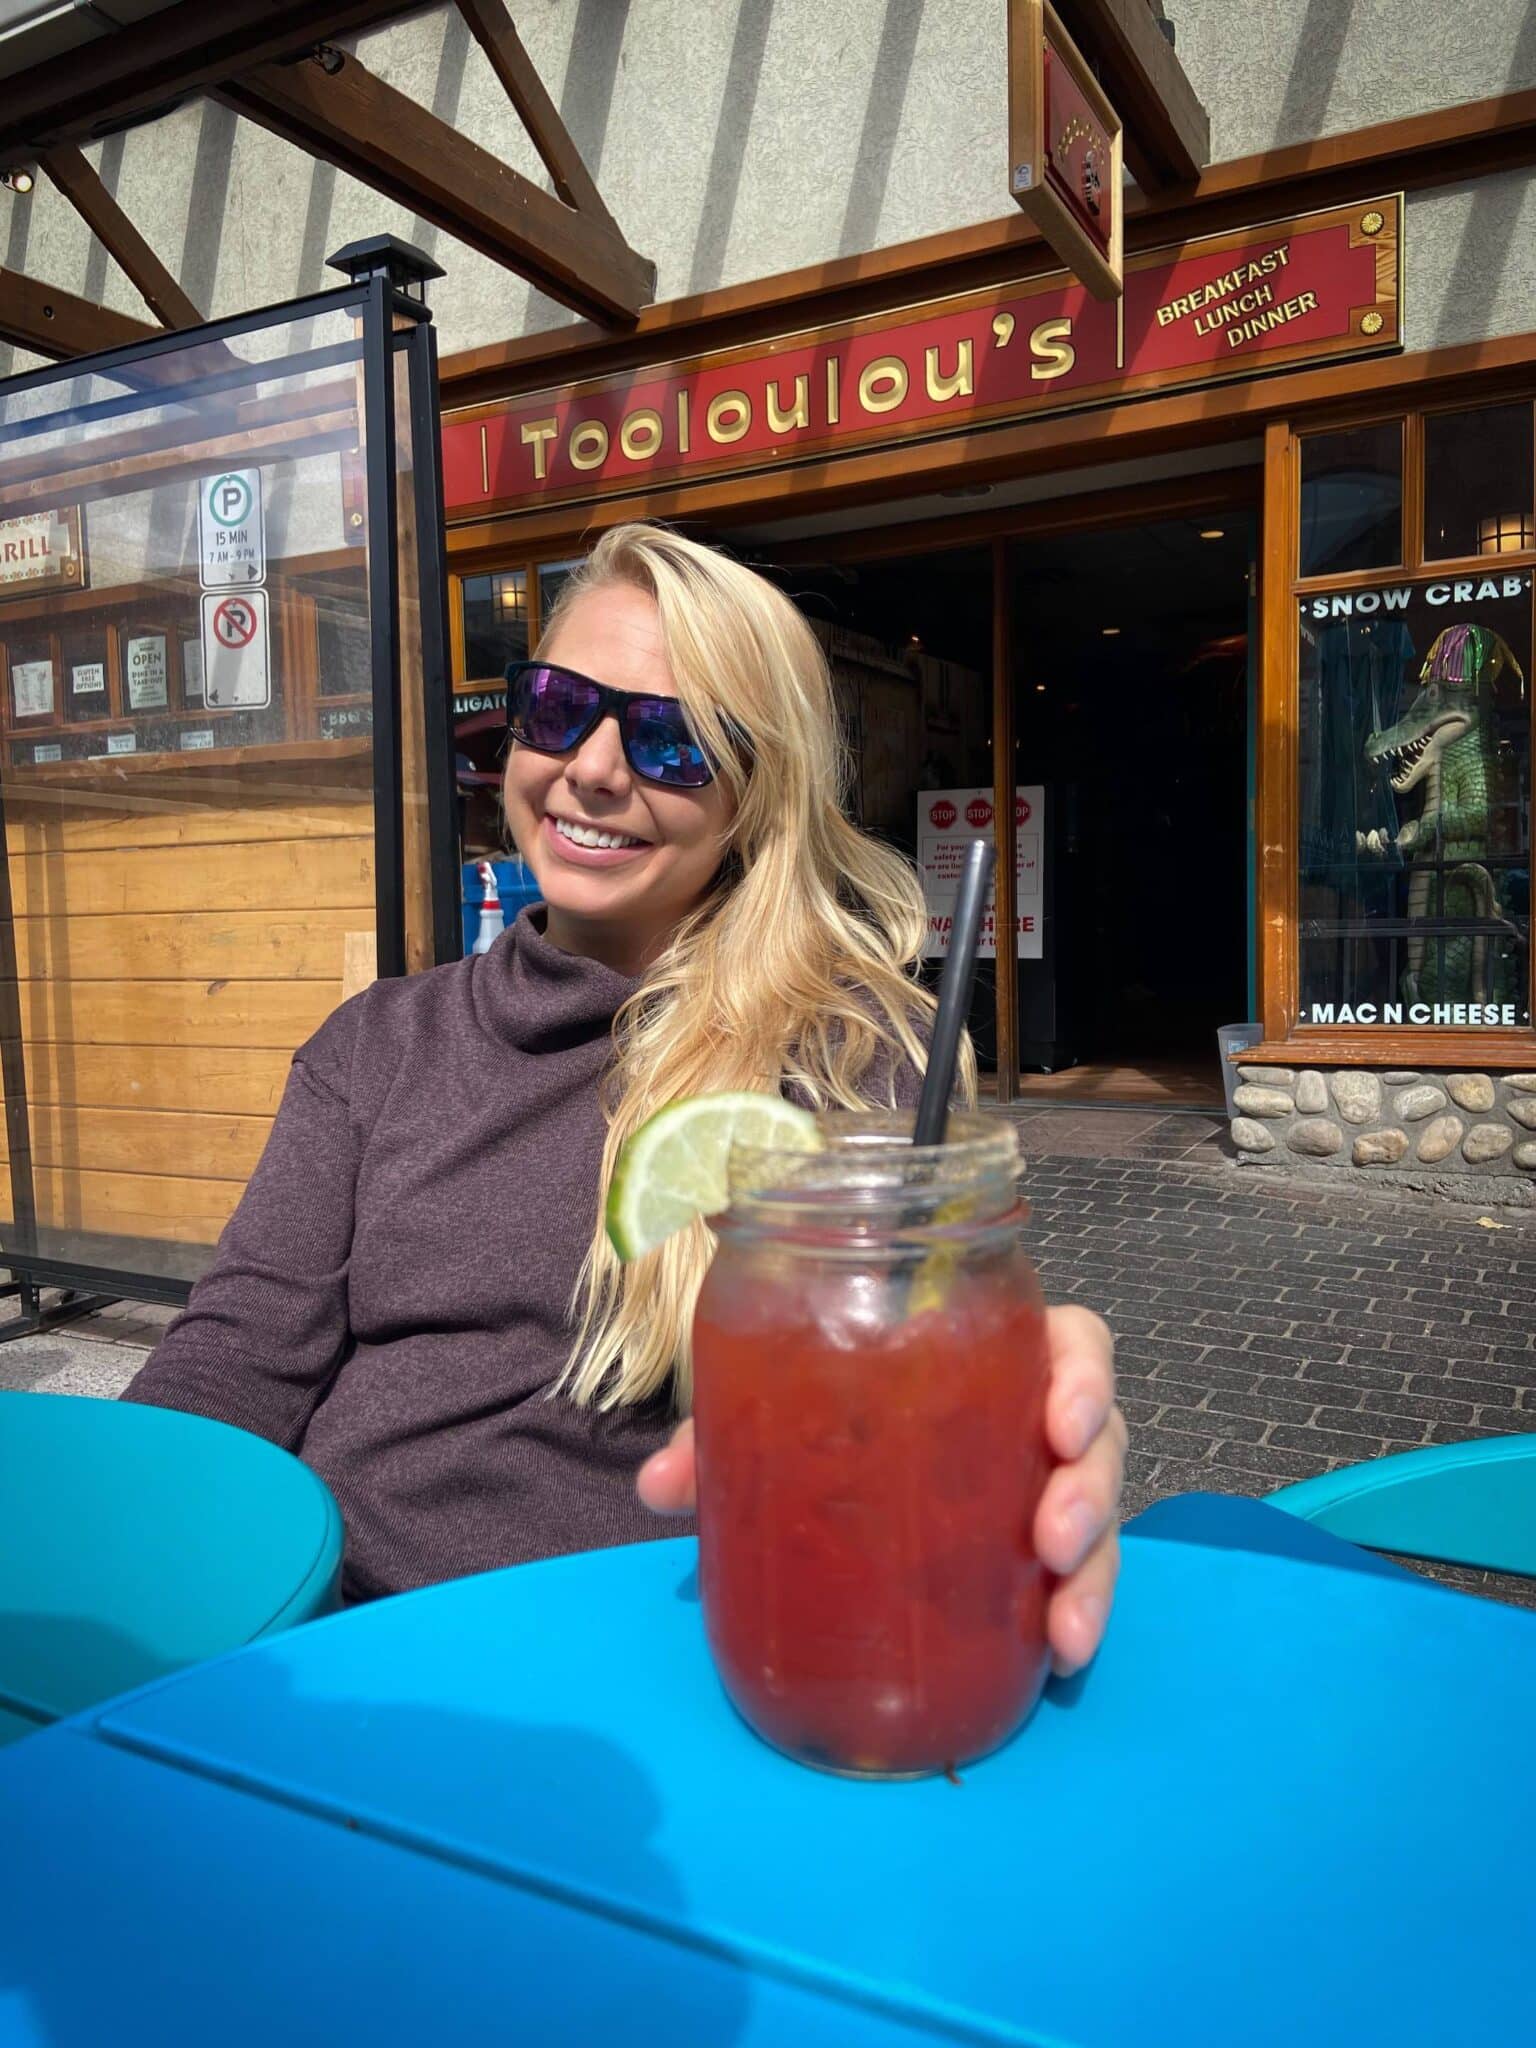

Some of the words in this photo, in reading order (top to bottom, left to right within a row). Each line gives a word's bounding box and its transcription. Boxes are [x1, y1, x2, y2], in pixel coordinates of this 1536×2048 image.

[1156, 245, 1289, 327] BREAKFAST
[1194, 284, 1274, 337] LUNCH
[1227, 291, 1319, 348] DINNER
[520, 311, 1077, 481] Tooloulou's
[0, 536, 52, 562] RILL
[216, 532, 226, 546] 15
[229, 530, 248, 544] MIN
[210, 552, 215, 563] 7
[217, 551, 228, 563] AM
[236, 548, 242, 560] 9
[244, 547, 255, 560] PM
[1312, 587, 1412, 618] SNOW
[1425, 575, 1522, 606] CRAB
[133, 652, 161, 666] OPEN
[932, 810, 955, 820] STOP
[967, 808, 991, 818] STOP
[1312, 1003, 1378, 1023] MAC
[1384, 1004, 1402, 1023] N
[1409, 1003, 1515, 1025] CHEESE
